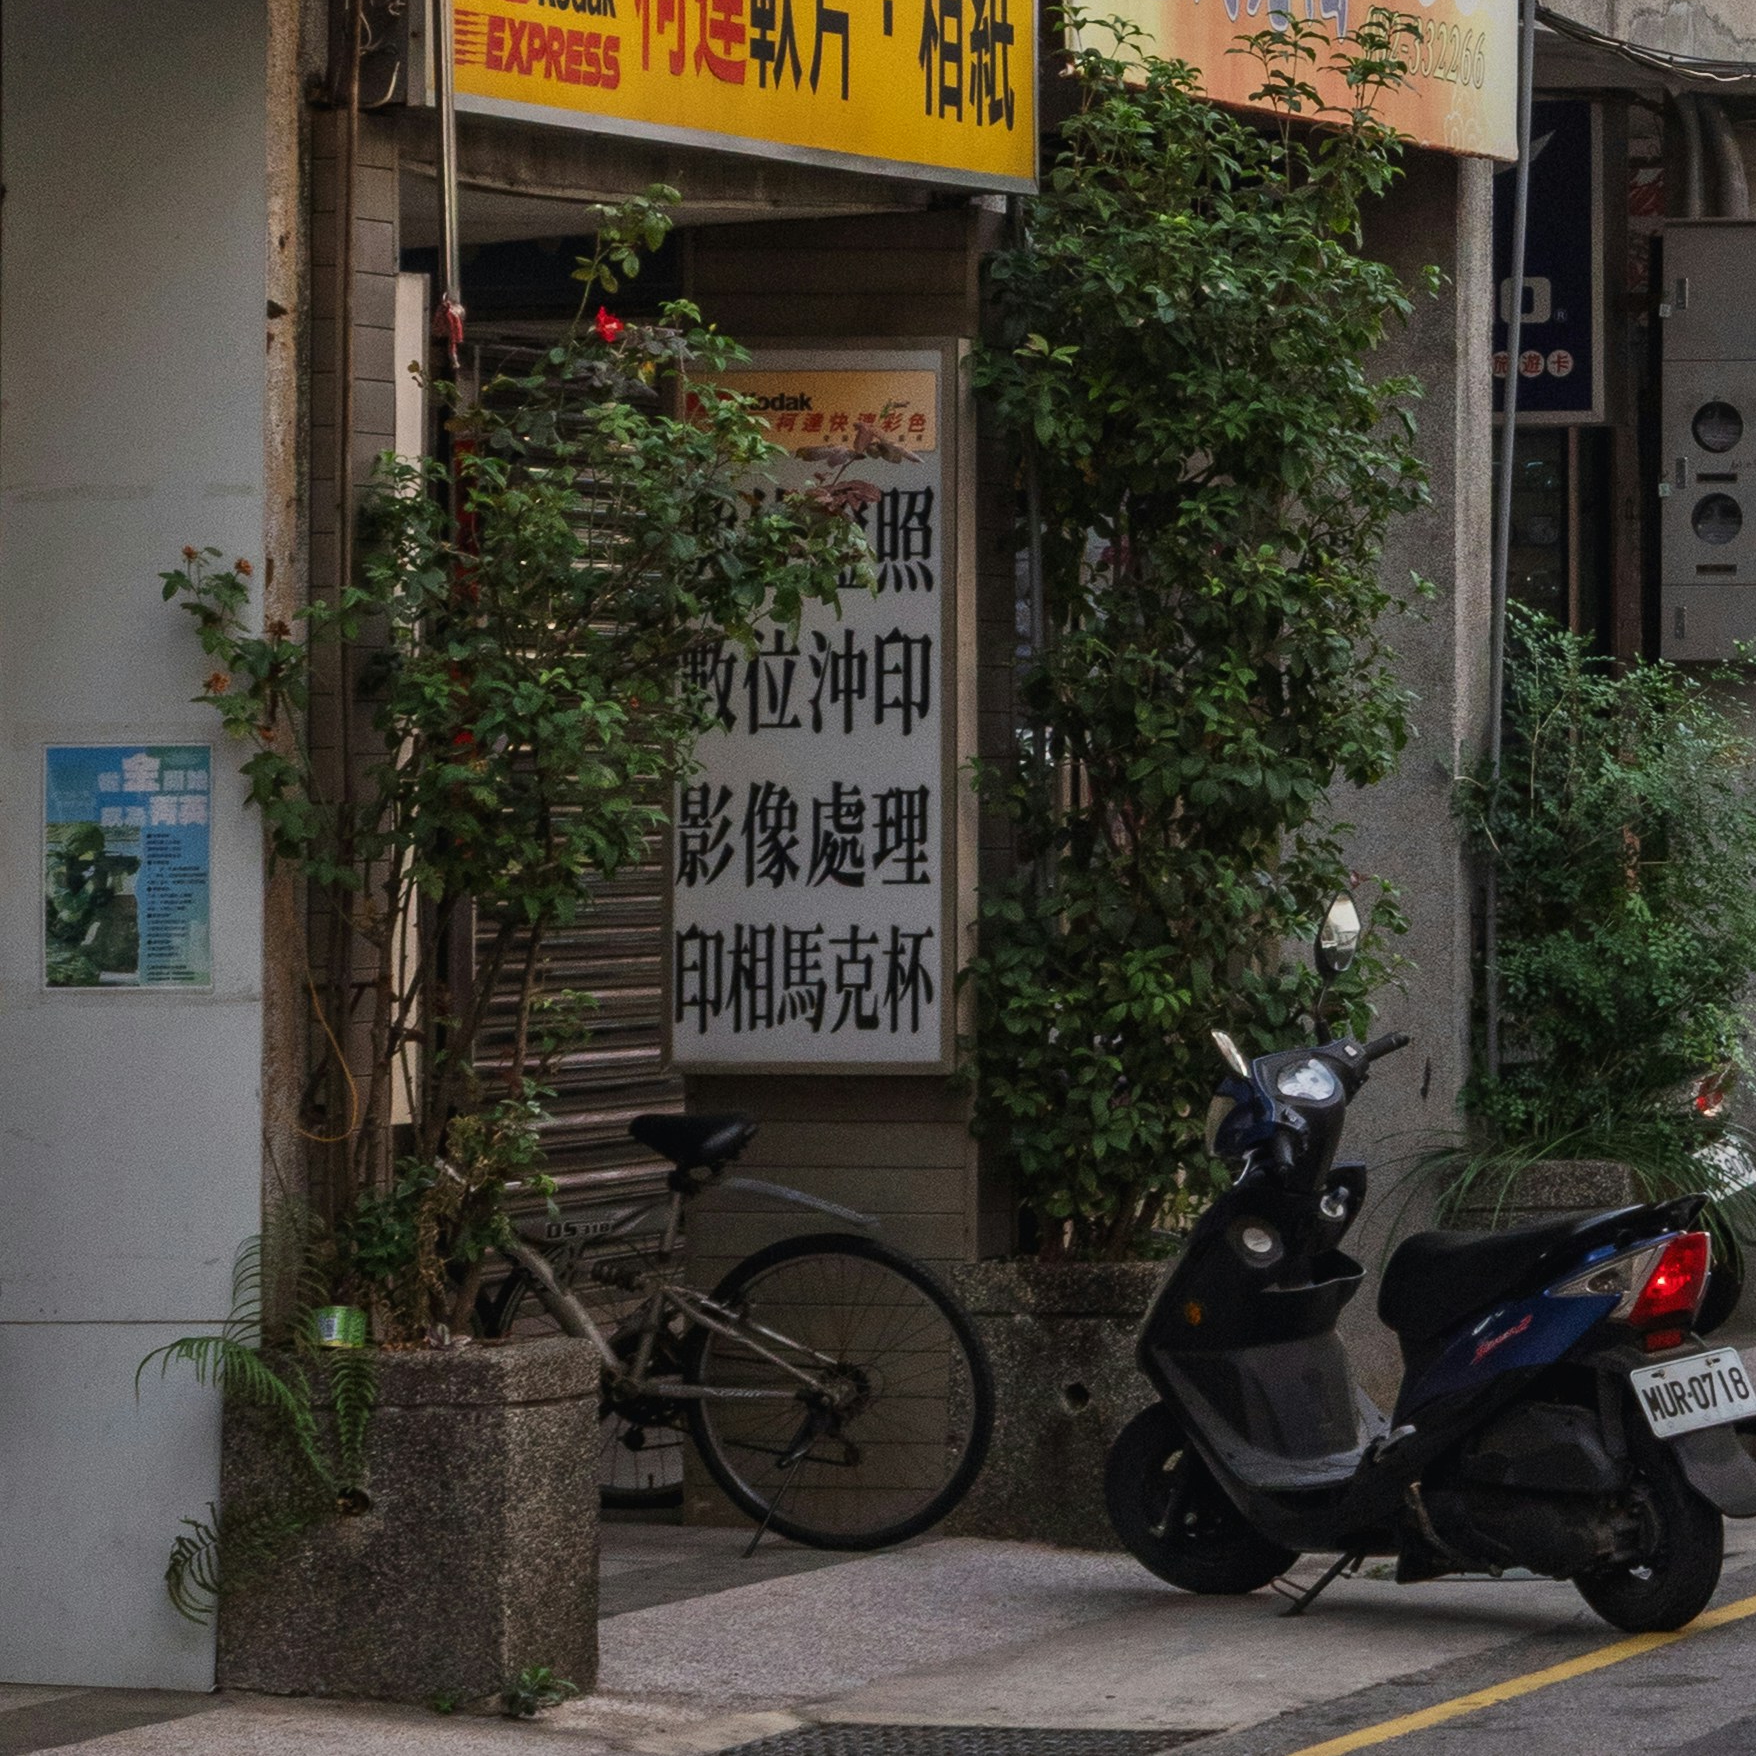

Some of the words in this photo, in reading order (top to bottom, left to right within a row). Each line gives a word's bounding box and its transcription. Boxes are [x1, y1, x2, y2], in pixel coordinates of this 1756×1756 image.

[485, 15, 622, 90] EXPRESS
[676, 778, 933, 890] 影像處理
[675, 920, 936, 1036] 印相馬克杯
[1640, 1366, 1751, 1425] MUR-0718
